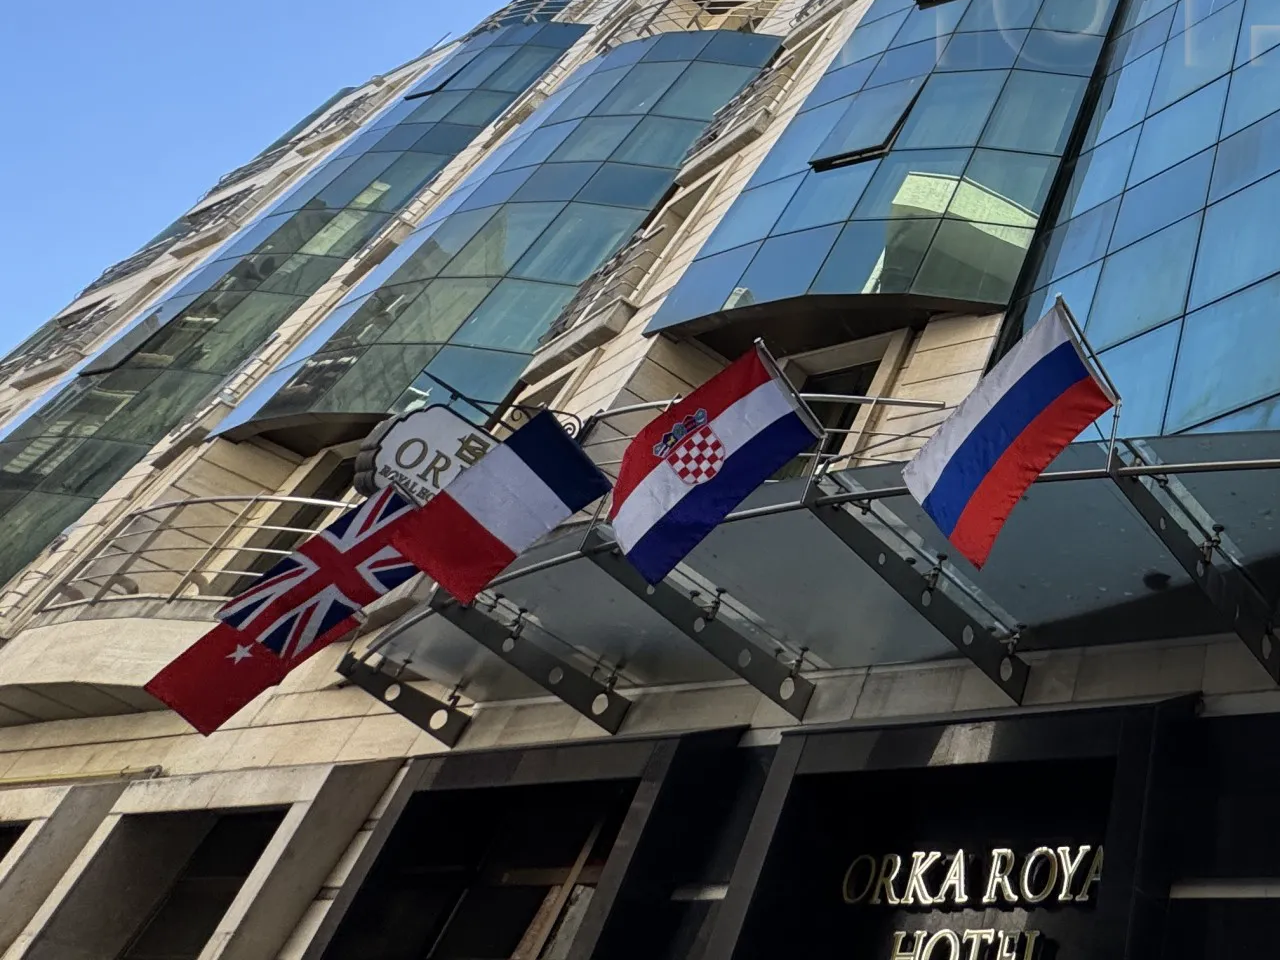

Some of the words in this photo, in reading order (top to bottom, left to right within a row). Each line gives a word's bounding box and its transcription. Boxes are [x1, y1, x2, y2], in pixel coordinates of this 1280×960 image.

[395, 437, 466, 489] OR
[842, 848, 969, 905] ORKA
[982, 844, 1105, 904] ROYA
